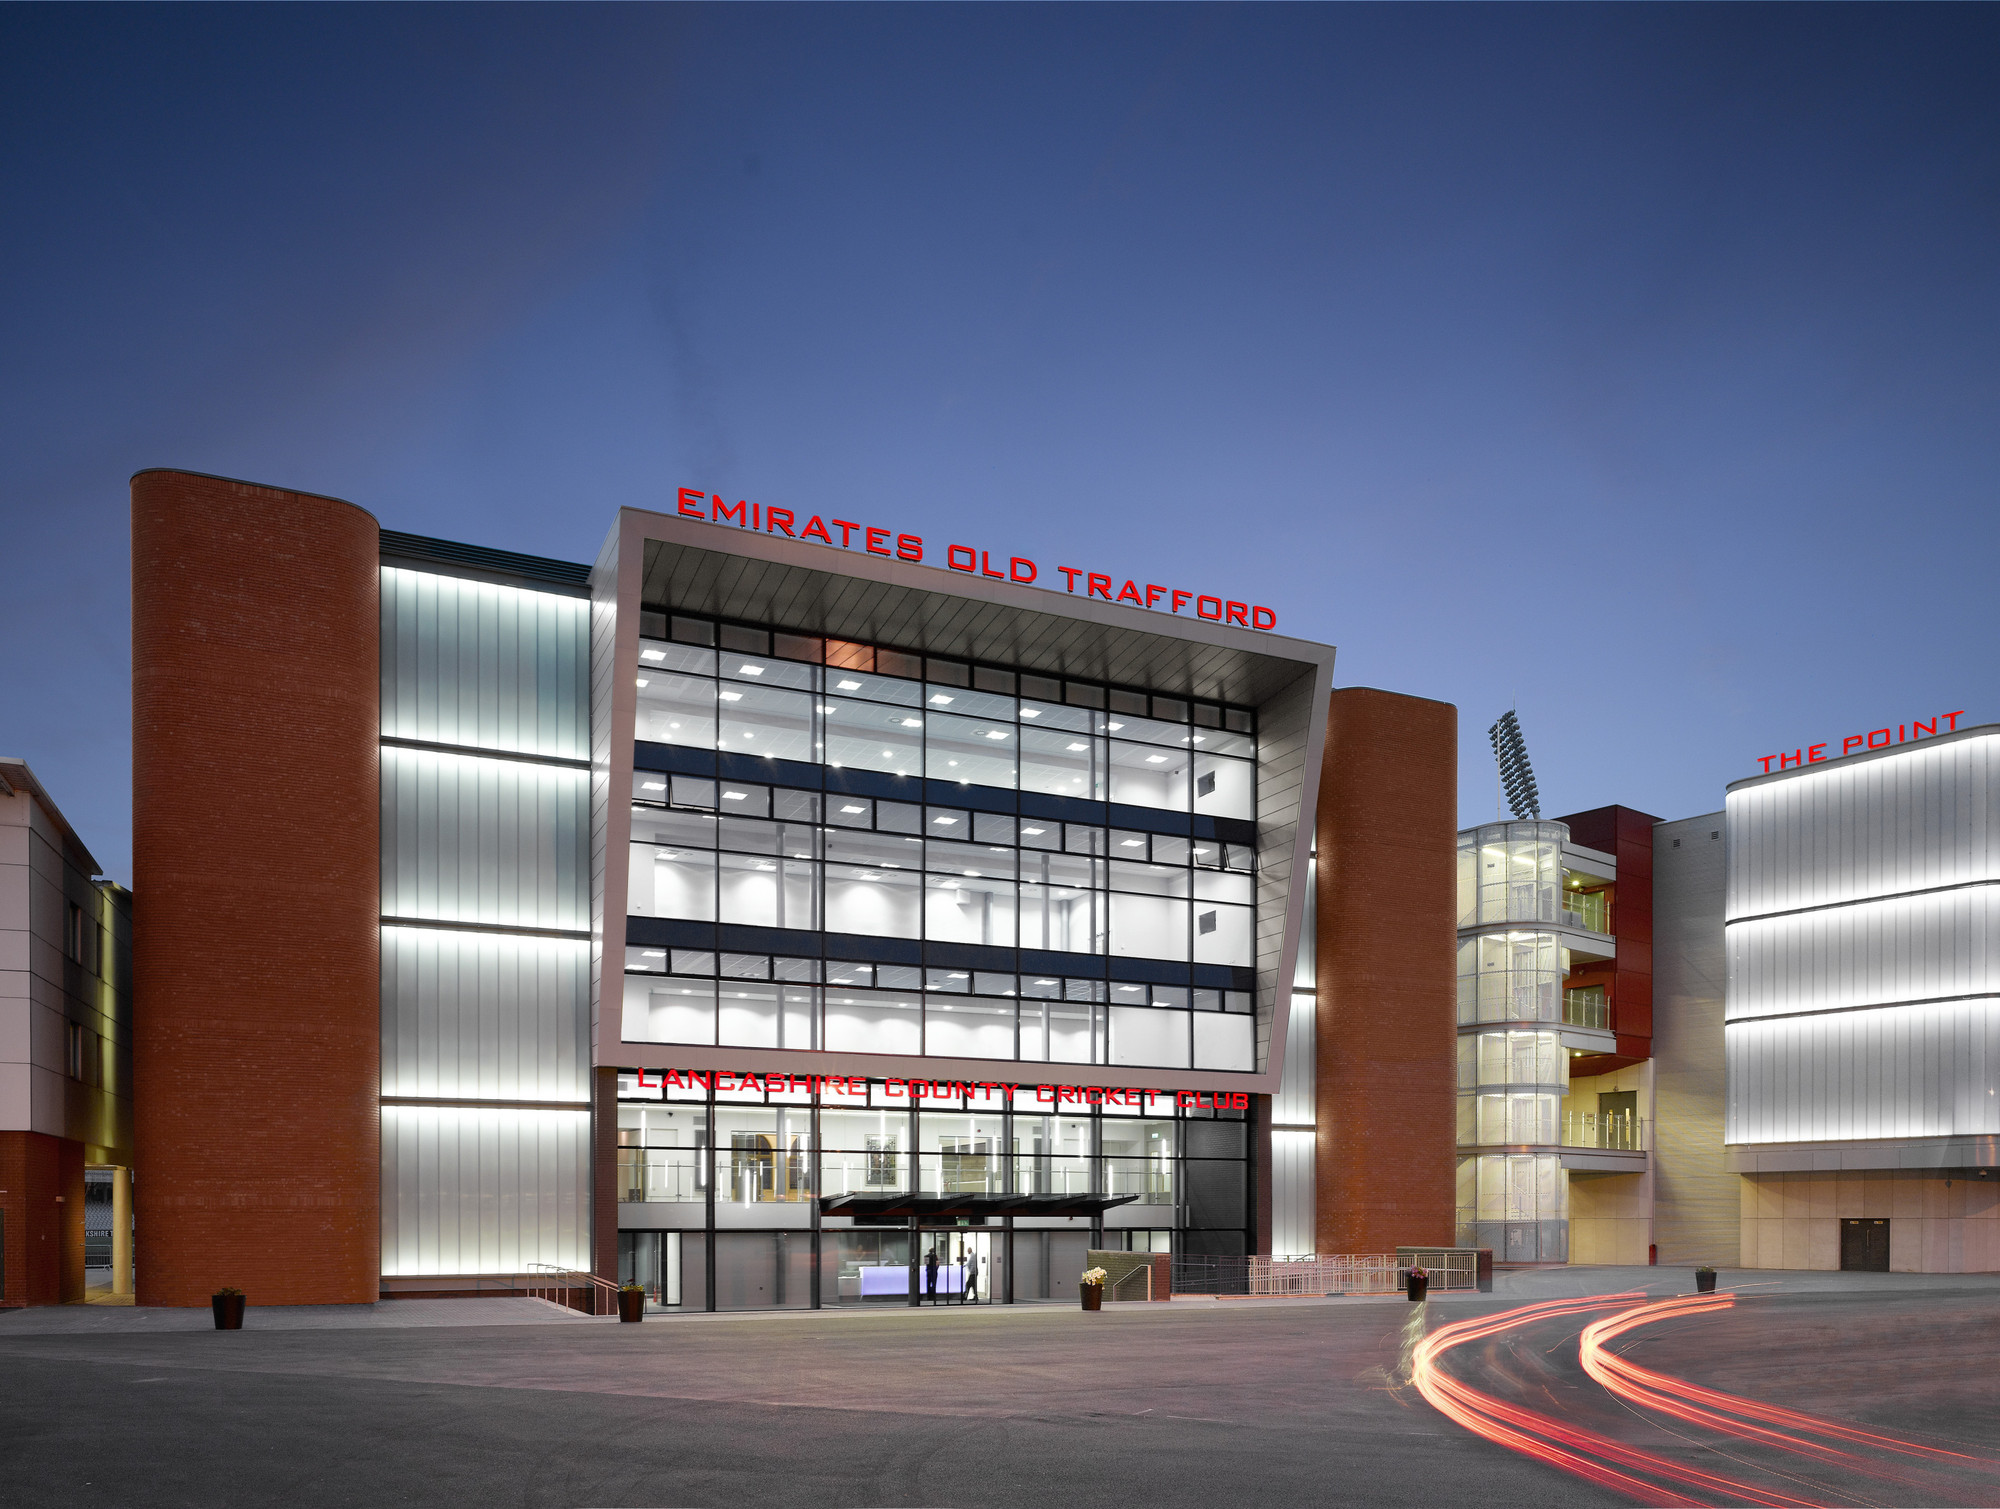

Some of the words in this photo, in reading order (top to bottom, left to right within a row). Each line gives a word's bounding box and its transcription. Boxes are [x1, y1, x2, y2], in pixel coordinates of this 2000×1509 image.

[677, 487, 923, 563] EMIRATES
[947, 543, 1039, 584] OLD
[1057, 565, 1277, 631] TRAFFORD
[1756, 742, 1828, 775] THE
[1842, 710, 1965, 757] POINT
[637, 1067, 868, 1097] LANCASHIRE
[884, 1078, 1020, 1103] COUNTY
[1036, 1084, 1162, 1108] CRICKET
[1176, 1090, 1250, 1112] CLUB
